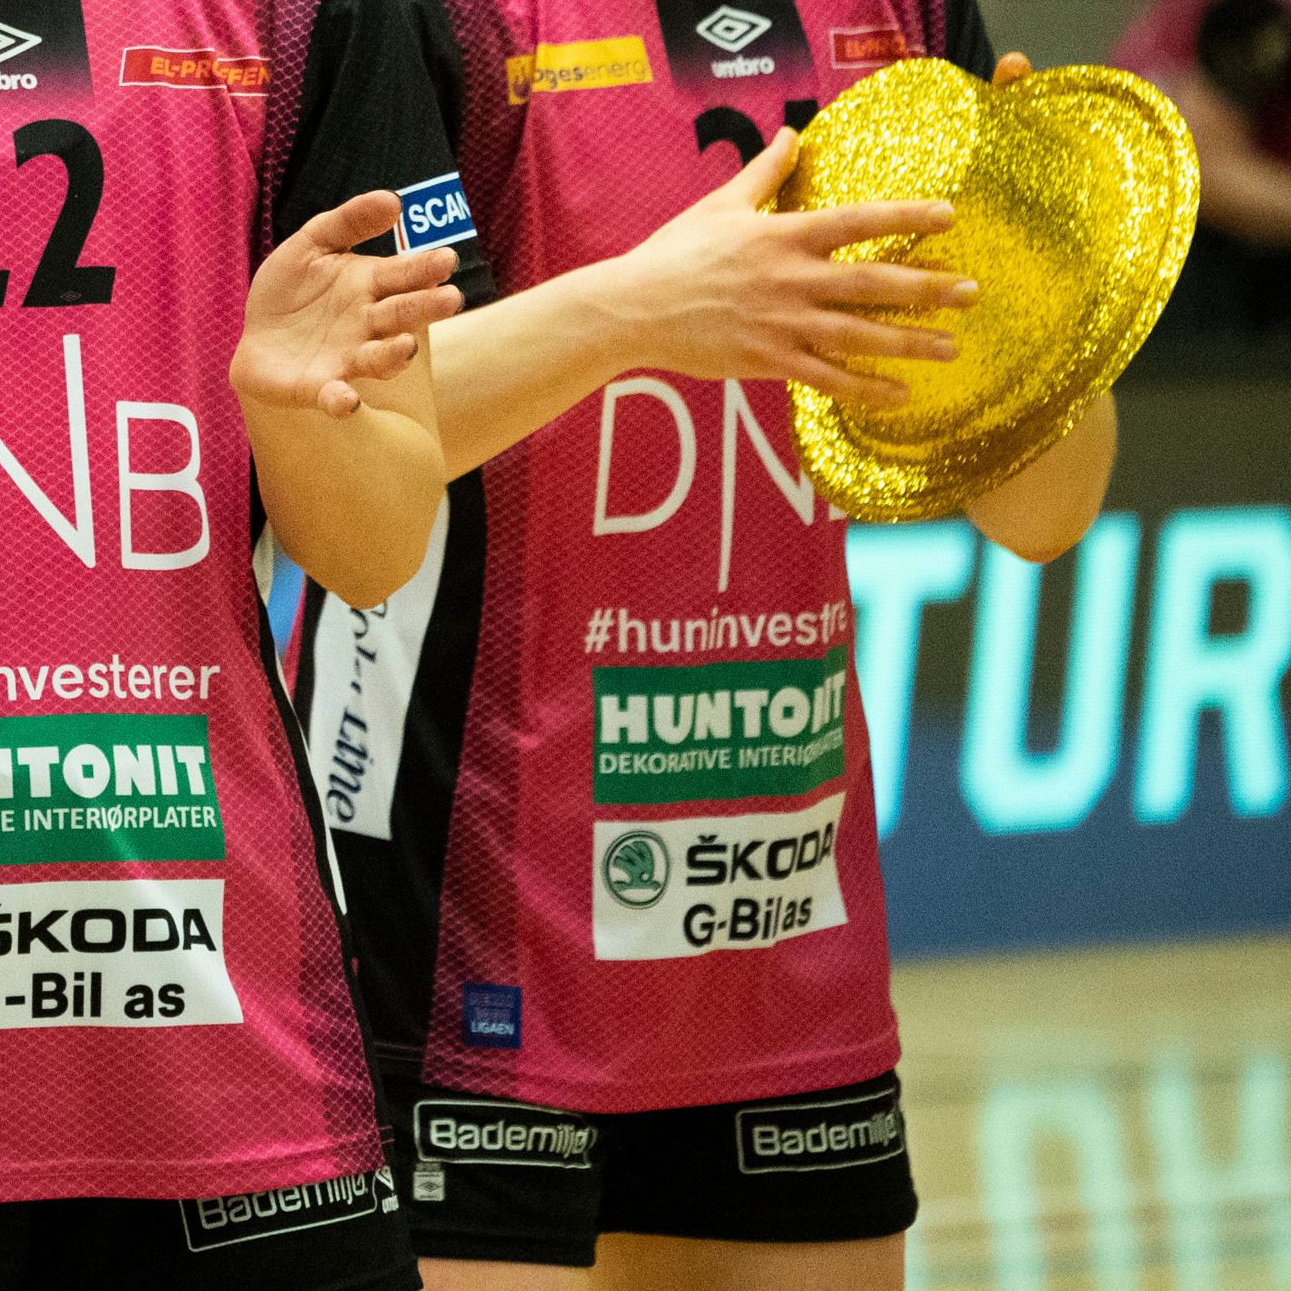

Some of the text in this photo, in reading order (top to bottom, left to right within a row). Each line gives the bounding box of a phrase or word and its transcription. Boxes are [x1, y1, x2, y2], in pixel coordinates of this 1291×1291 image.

[597, 747, 732, 776] DEKORATIVE
[24, 803, 218, 833] INTERIØRPLATER
[686, 821, 835, 888] ŠKODA
[683, 895, 813, 948] G-Bil as
[124, 982, 186, 1019] as
